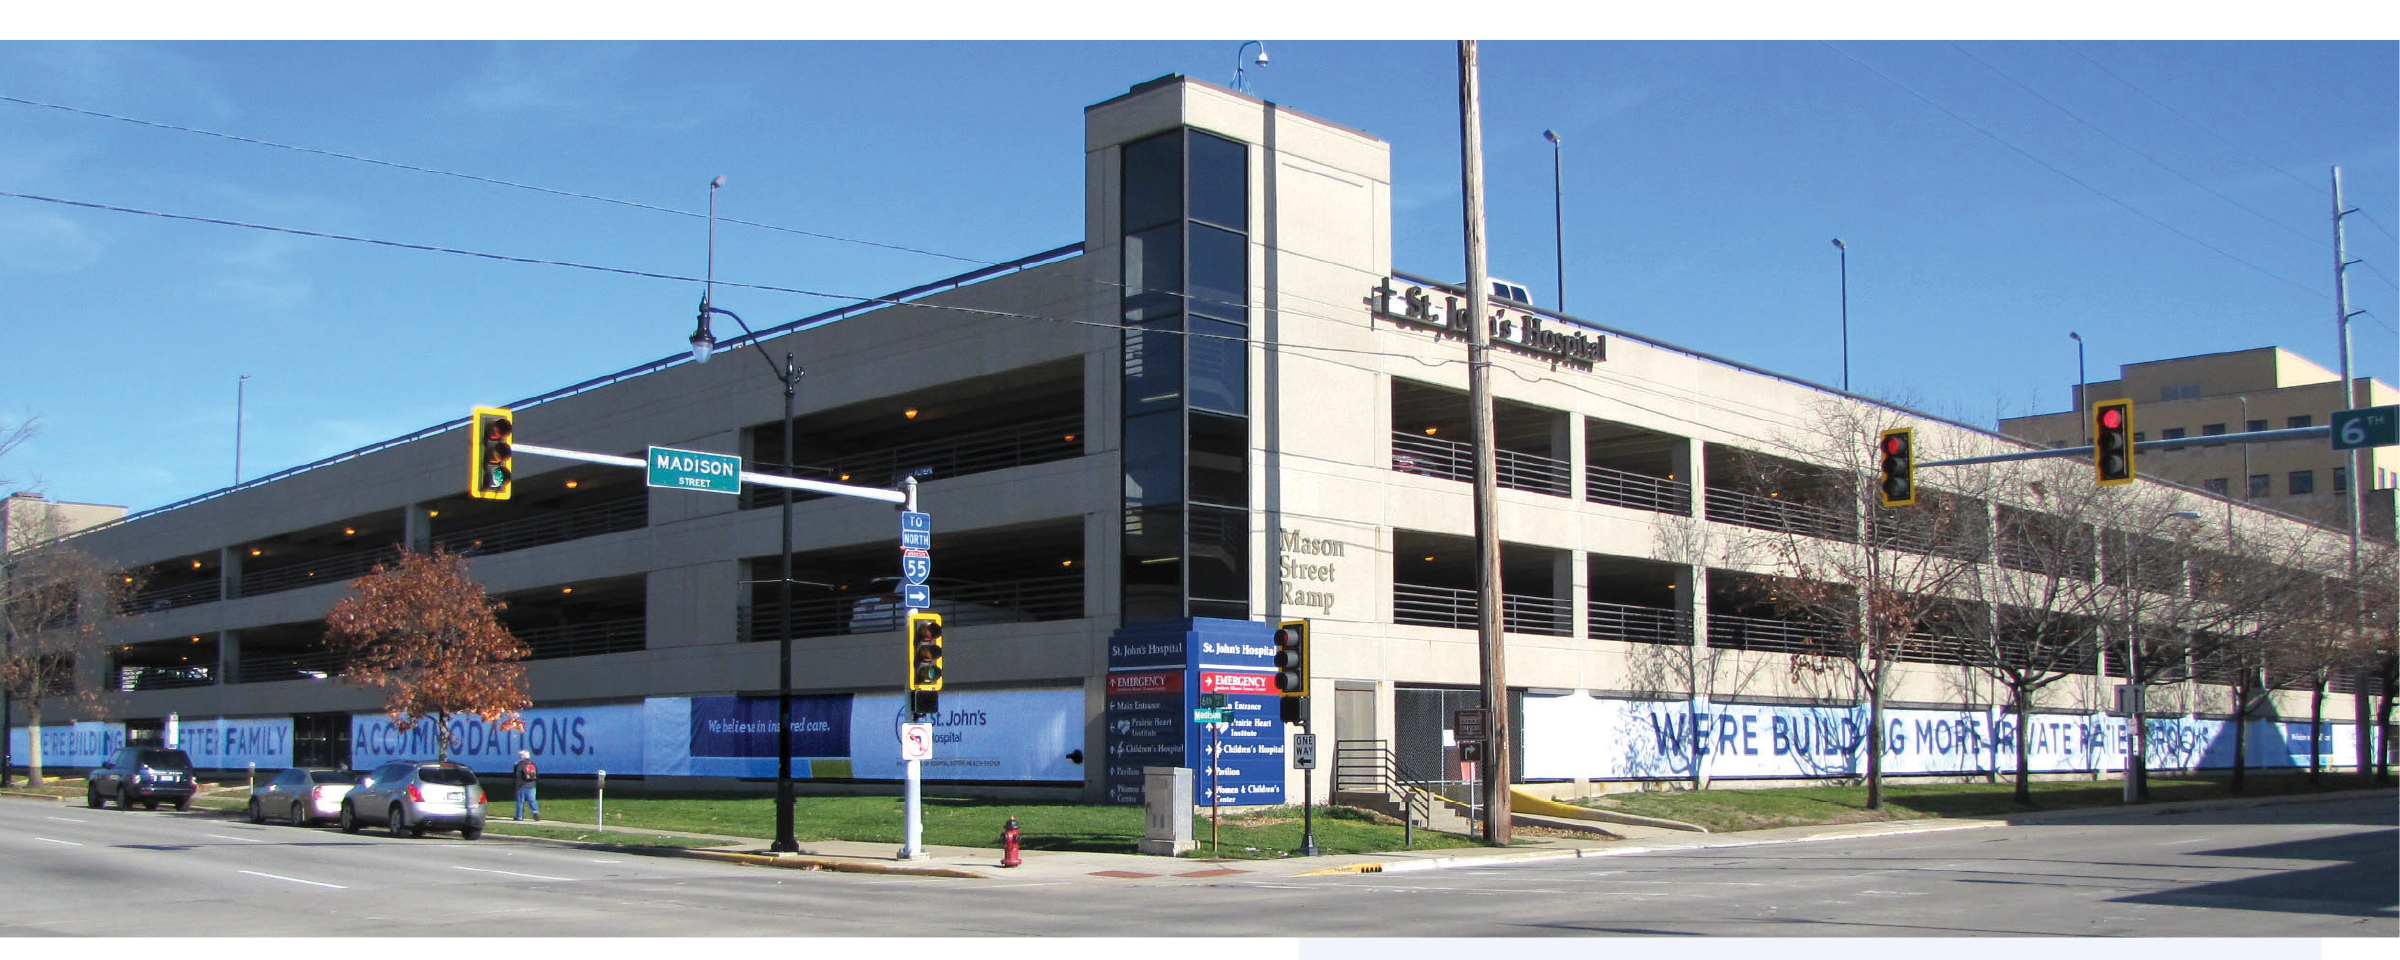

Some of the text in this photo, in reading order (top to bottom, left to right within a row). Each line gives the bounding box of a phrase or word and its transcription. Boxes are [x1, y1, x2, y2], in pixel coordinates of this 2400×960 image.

[1405, 286, 1607, 362] St. Jon's Hospital
[657, 455, 733, 476] MADISON
[679, 477, 711, 488] STREET
[910, 516, 923, 527] TO
[904, 533, 929, 545] NORTH
[1280, 528, 1345, 557] Mason
[908, 559, 927, 577] 55
[1279, 555, 1336, 582] Street
[1280, 580, 1335, 615] Ramp
[1112, 642, 1183, 657] St. John's Hospital
[1203, 642, 1277, 658] St. John's Hospital
[1117, 676, 1166, 687] EMERGENCY
[1215, 675, 1267, 687] EMERGENCY
[1117, 701, 1160, 710] Main Entrance
[1234, 701, 1262, 711] Entrance
[931, 709, 987, 727] St. John's
[1194, 710, 1221, 720] Madison
[708, 718, 830, 733] We believe in insred care.
[1154, 717, 1172, 726] Heart
[1254, 718, 1272, 727] Heart
[1231, 729, 1258, 737] Institute
[225, 726, 288, 755] FAMILY
[1296, 736, 1313, 745] ONE
[1125, 743, 1184, 755] Children's Hospital
[1223, 744, 1284, 756] Children's Hospital
[1296, 747, 1313, 756] WAY
[1215, 767, 1240, 776] Pavilion
[1241, 785, 1246, 794] &
[1247, 784, 1280, 793] Children's
